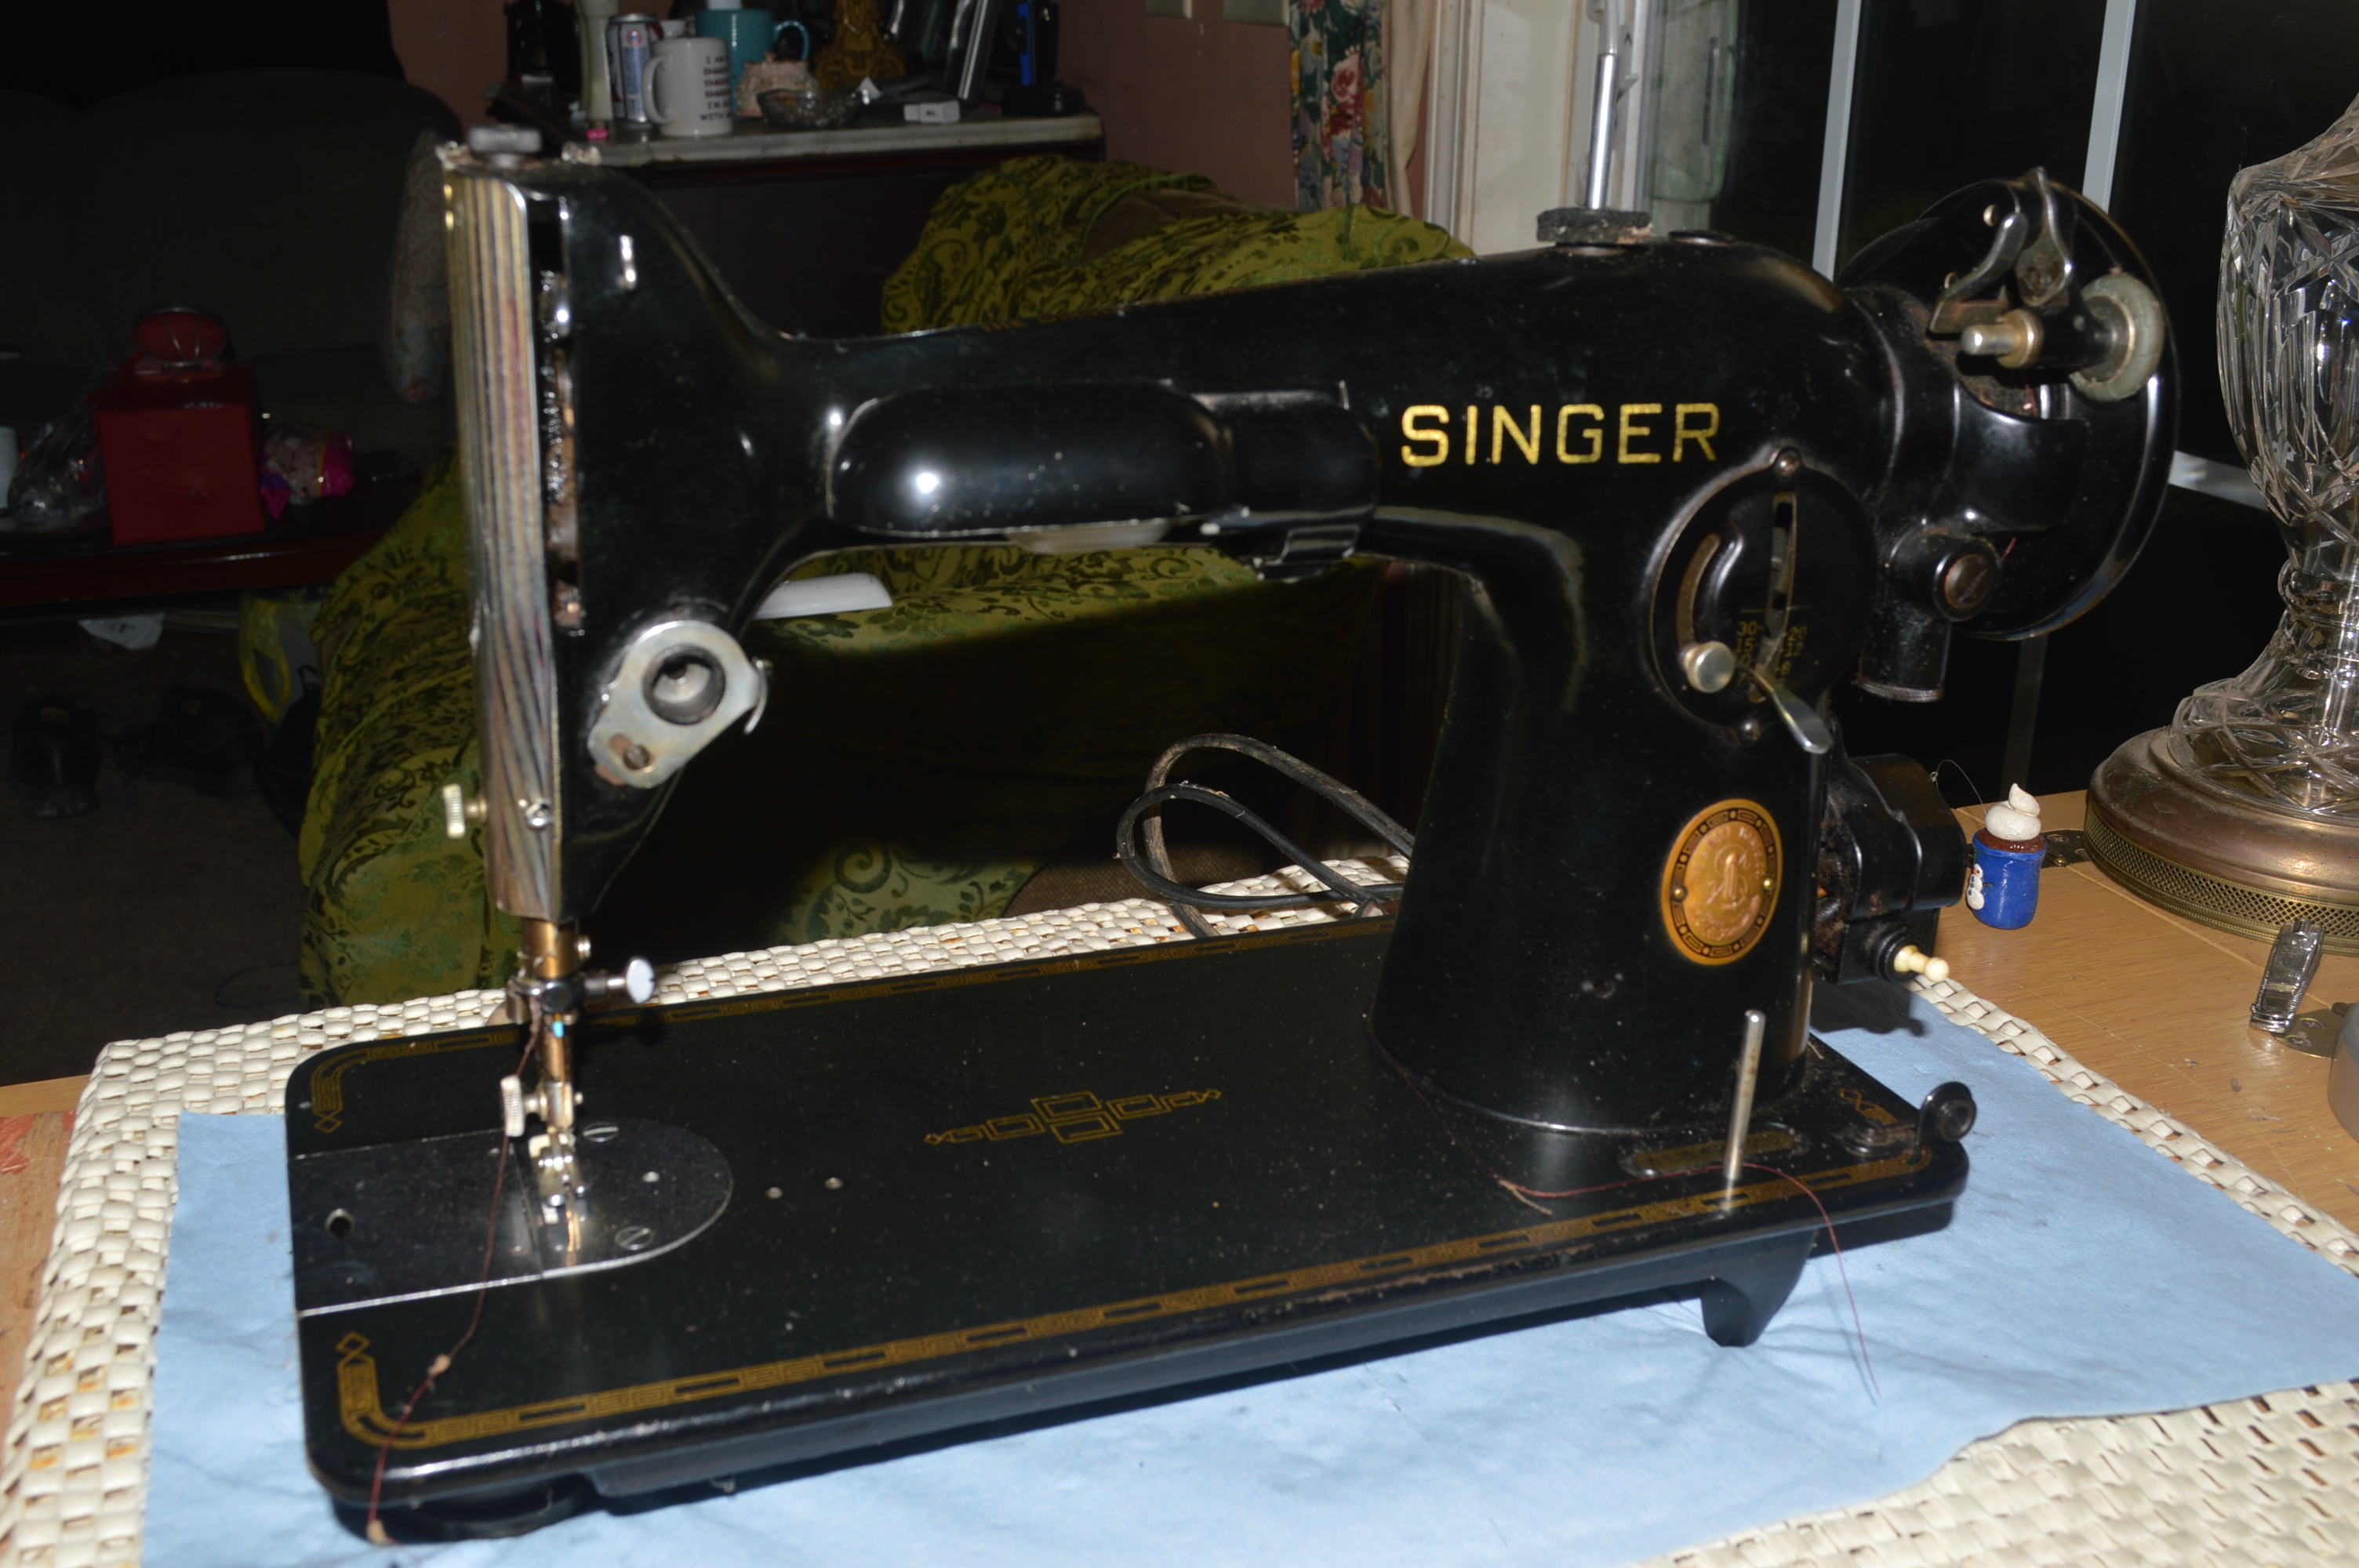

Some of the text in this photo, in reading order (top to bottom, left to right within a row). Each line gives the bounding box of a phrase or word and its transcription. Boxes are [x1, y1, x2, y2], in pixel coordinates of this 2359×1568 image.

[1401, 402, 1720, 467] SINGER
[1736, 620, 1758, 637] 30
[1788, 626, 1807, 641] 20
[1736, 637, 1755, 653] 15
[1785, 641, 1805, 657] 12
[1781, 662, 1791, 675] 8
